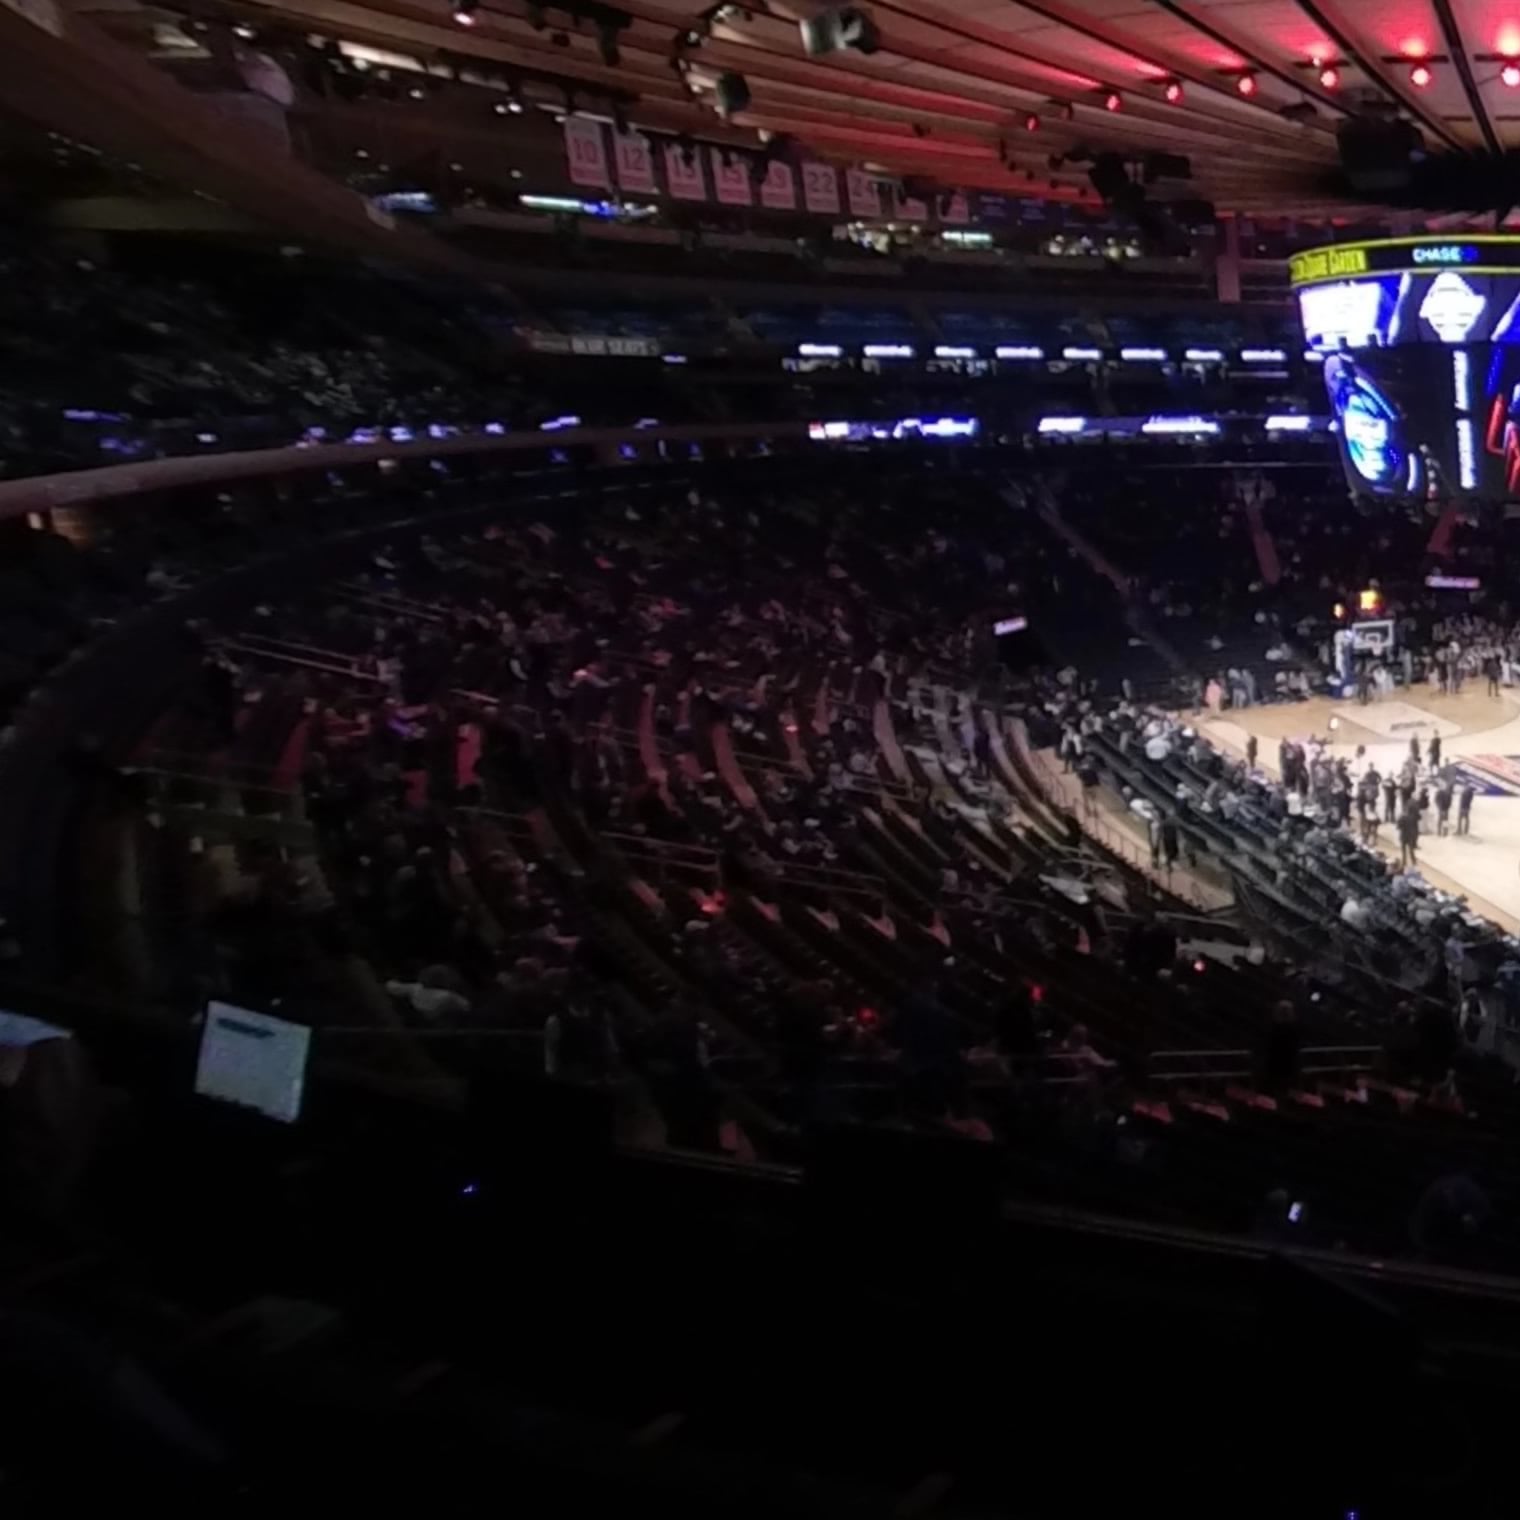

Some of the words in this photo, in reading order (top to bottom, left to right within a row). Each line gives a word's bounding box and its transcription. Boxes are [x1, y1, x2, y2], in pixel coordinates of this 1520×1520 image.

[573, 138, 597, 163] 10
[622, 147, 644, 171] 12
[807, 171, 834, 193] 22
[1412, 246, 1462, 263] CHASE
